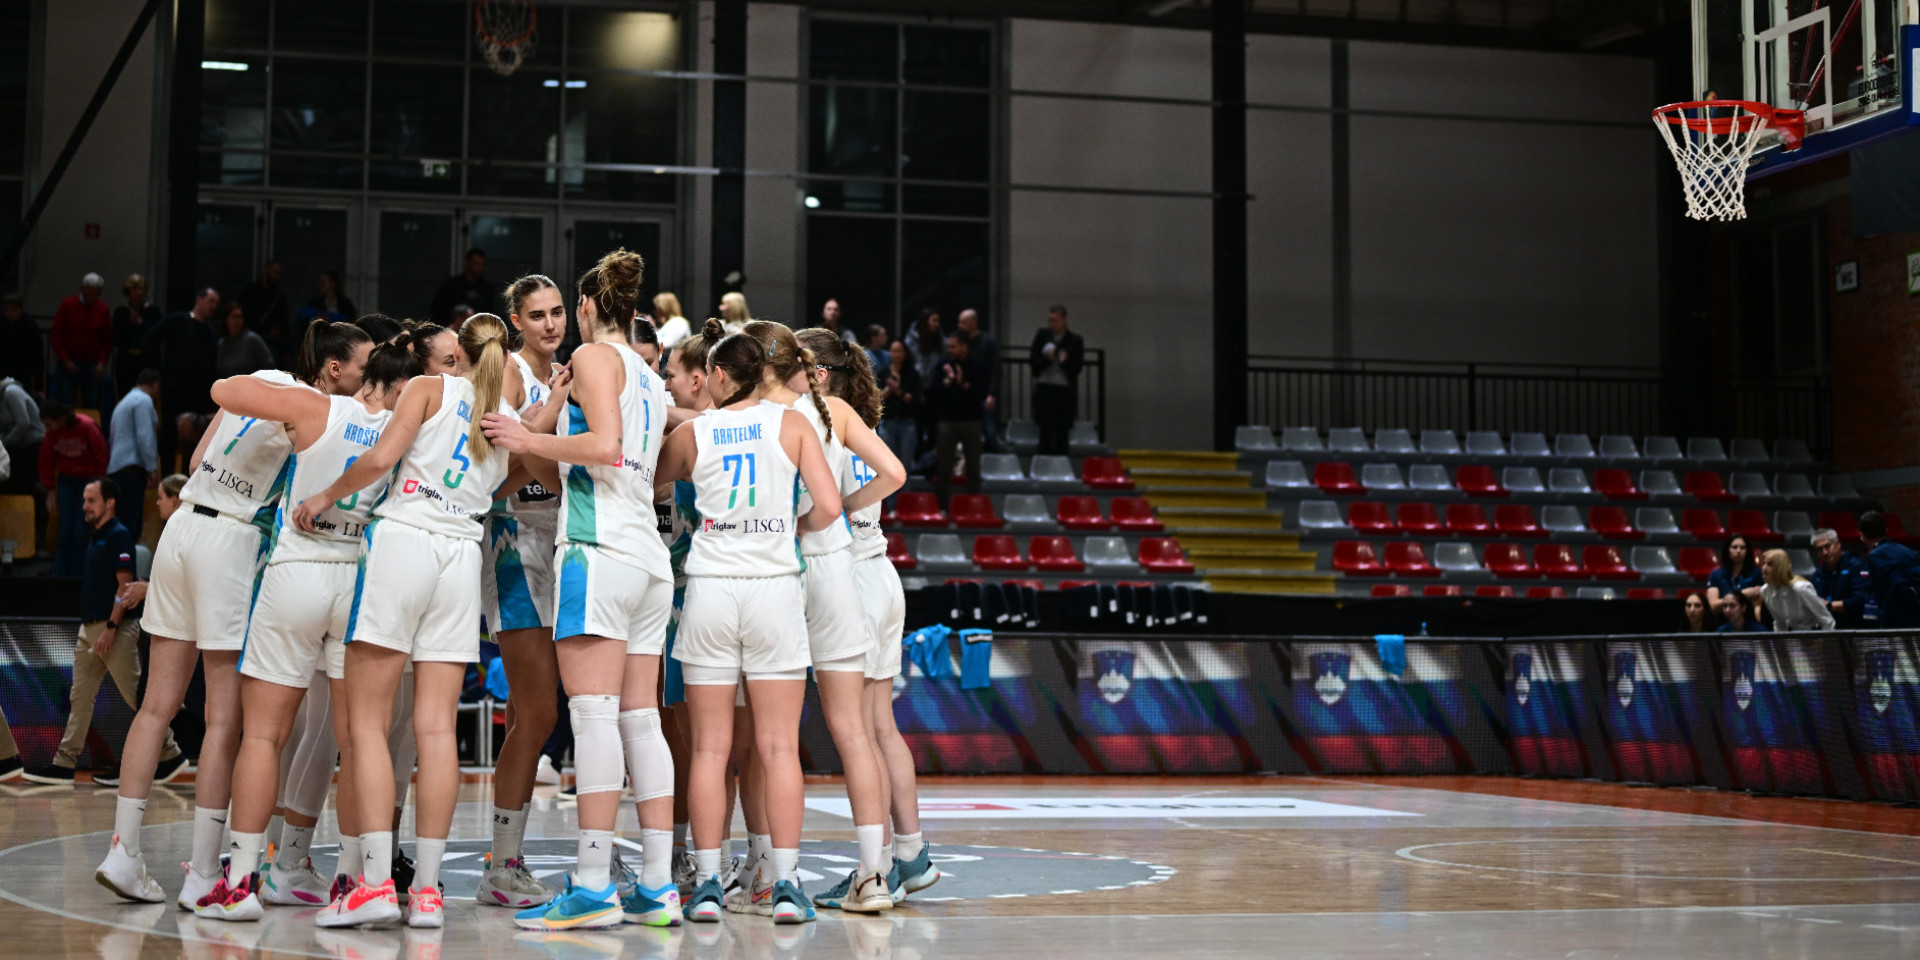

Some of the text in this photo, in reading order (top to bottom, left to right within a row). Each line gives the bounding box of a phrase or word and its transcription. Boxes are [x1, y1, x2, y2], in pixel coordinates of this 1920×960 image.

[643, 399, 649, 453] 1
[713, 424, 763, 445] BARTELME
[442, 432, 470, 489] 5
[217, 468, 254, 498] LISCA
[723, 453, 756, 509] 71
[744, 518, 785, 534] LISCA
[494, 814, 509, 825] 23
